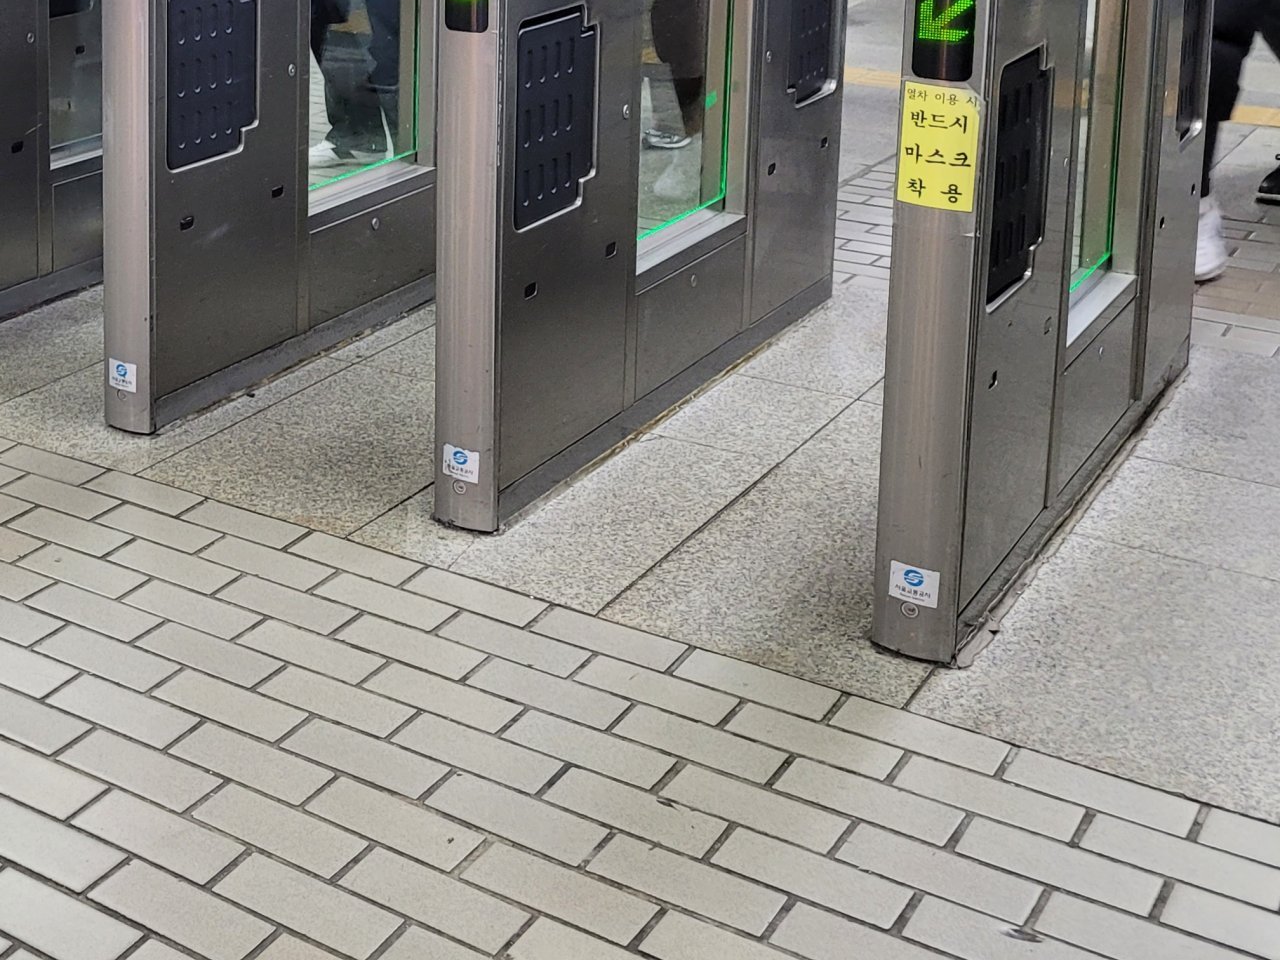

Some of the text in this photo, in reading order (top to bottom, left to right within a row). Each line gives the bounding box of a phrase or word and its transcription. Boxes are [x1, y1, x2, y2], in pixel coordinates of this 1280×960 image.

[907, 88, 978, 108] 열차 이용 시
[910, 109, 968, 134] 반드시
[905, 143, 971, 168] 마스크
